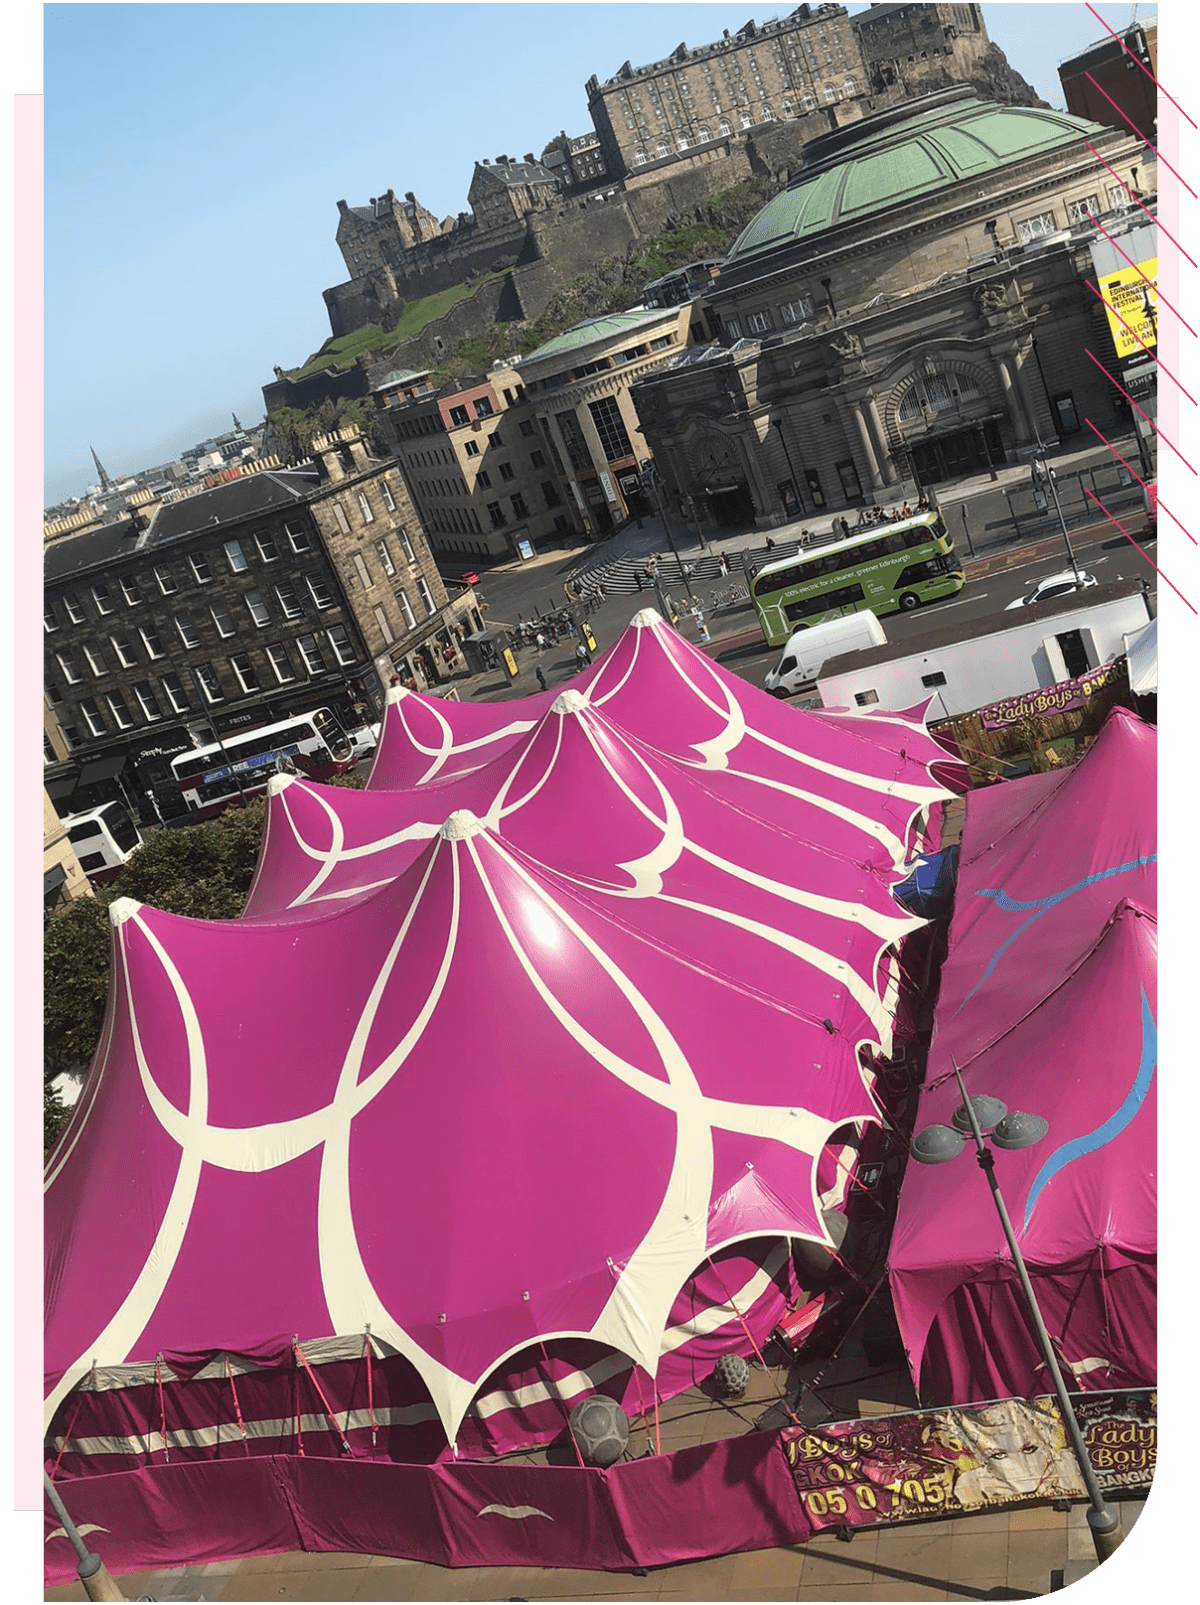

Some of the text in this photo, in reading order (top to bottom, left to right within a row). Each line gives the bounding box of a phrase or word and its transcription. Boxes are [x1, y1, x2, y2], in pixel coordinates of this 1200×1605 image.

[1113, 294, 1143, 309] FESTIVAL
[1128, 373, 1153, 389] USHER
[784, 589, 800, 598] 100%
[799, 582, 820, 593] electric
[856, 564, 879, 577] greener
[879, 554, 911, 568] Edinburgh
[996, 700, 1034, 723] Lady
[1034, 690, 1073, 712] Boys
[229, 714, 252, 724] FRITES
[798, 1433, 874, 1459] Boys
[1085, 1423, 1155, 1448] Lady
[1091, 1447, 1158, 1469] Boys
